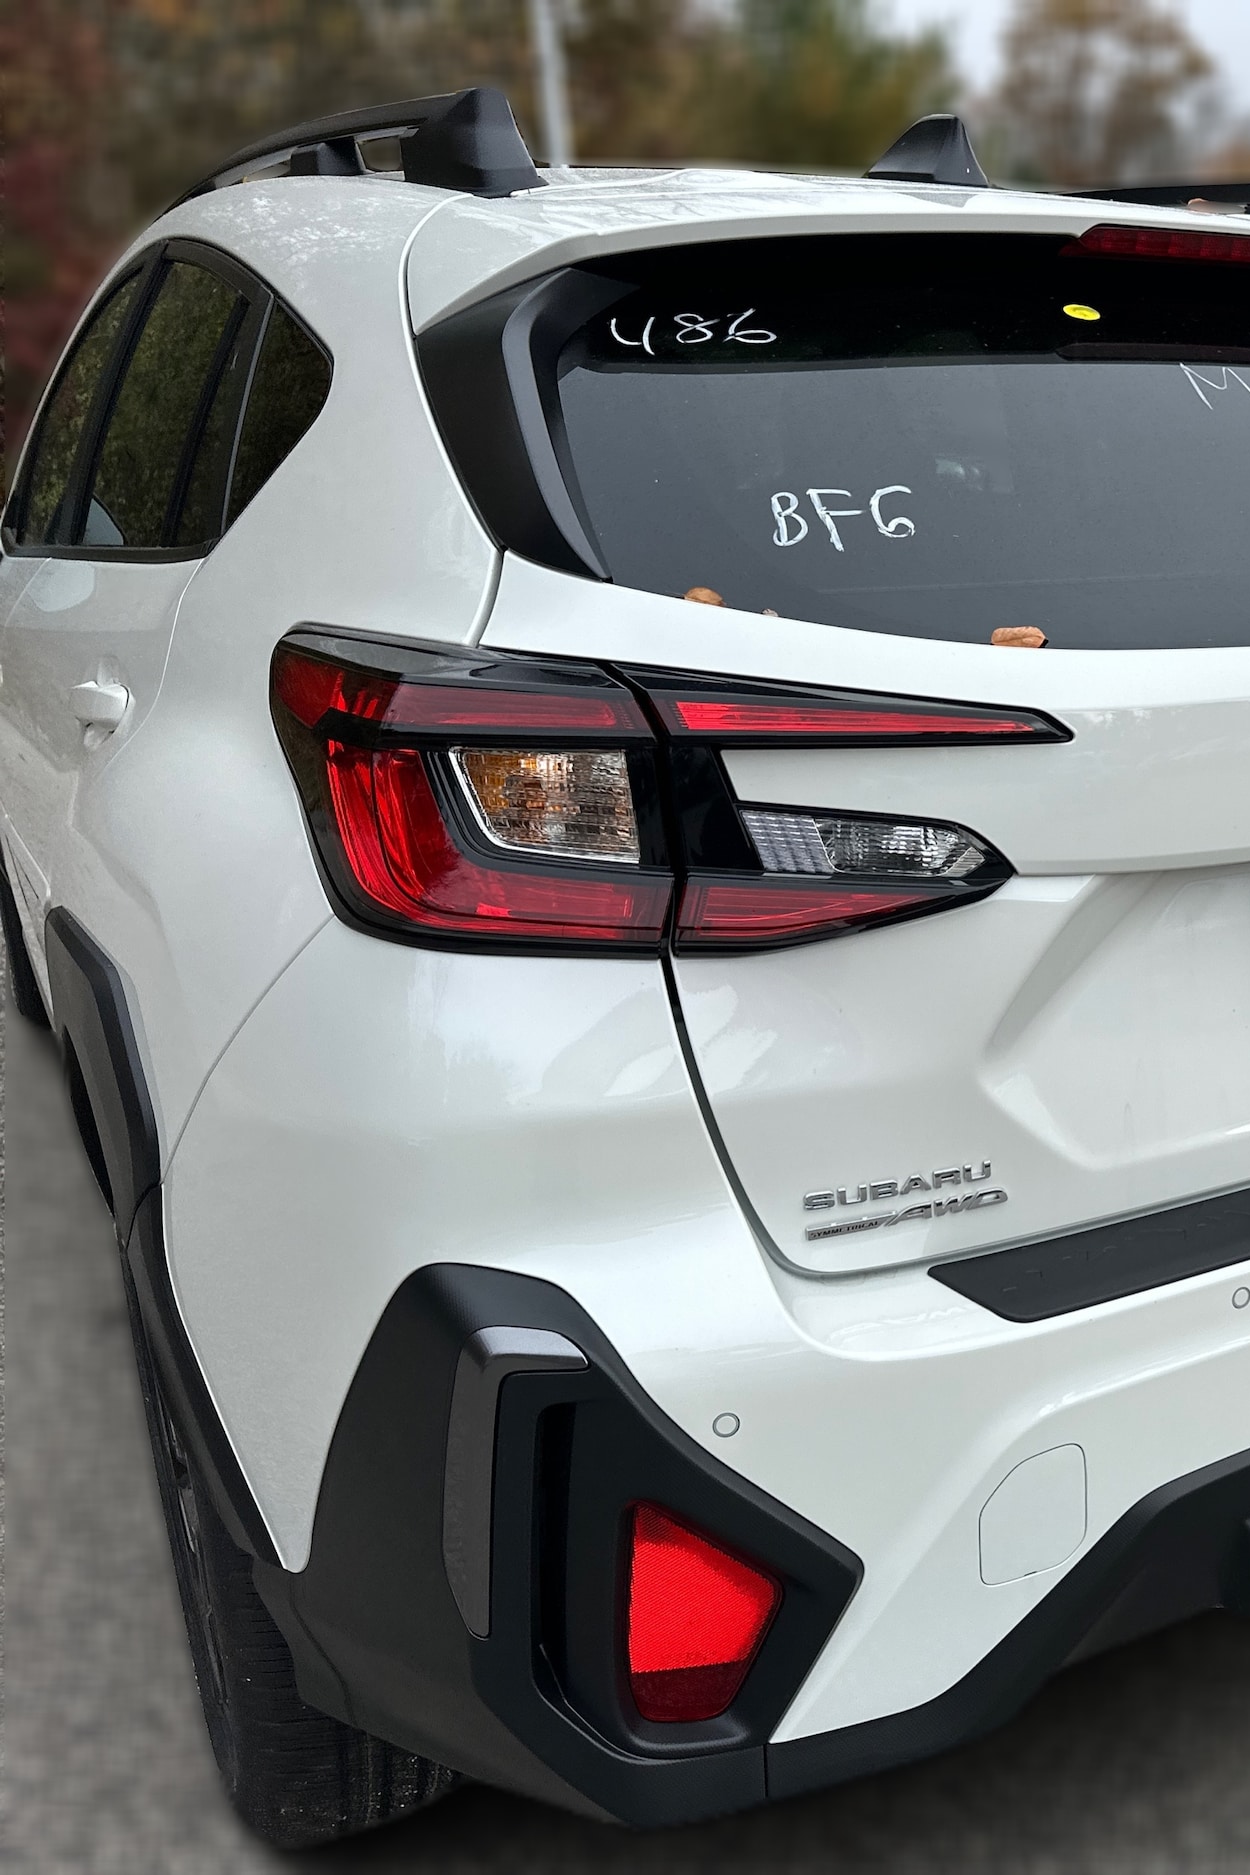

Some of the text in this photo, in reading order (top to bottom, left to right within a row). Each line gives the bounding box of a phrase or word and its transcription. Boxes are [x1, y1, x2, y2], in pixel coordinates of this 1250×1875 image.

[609, 307, 778, 356] 486
[803, 1159, 992, 1212] SUBARU
[885, 1186, 1009, 1227] AWD
